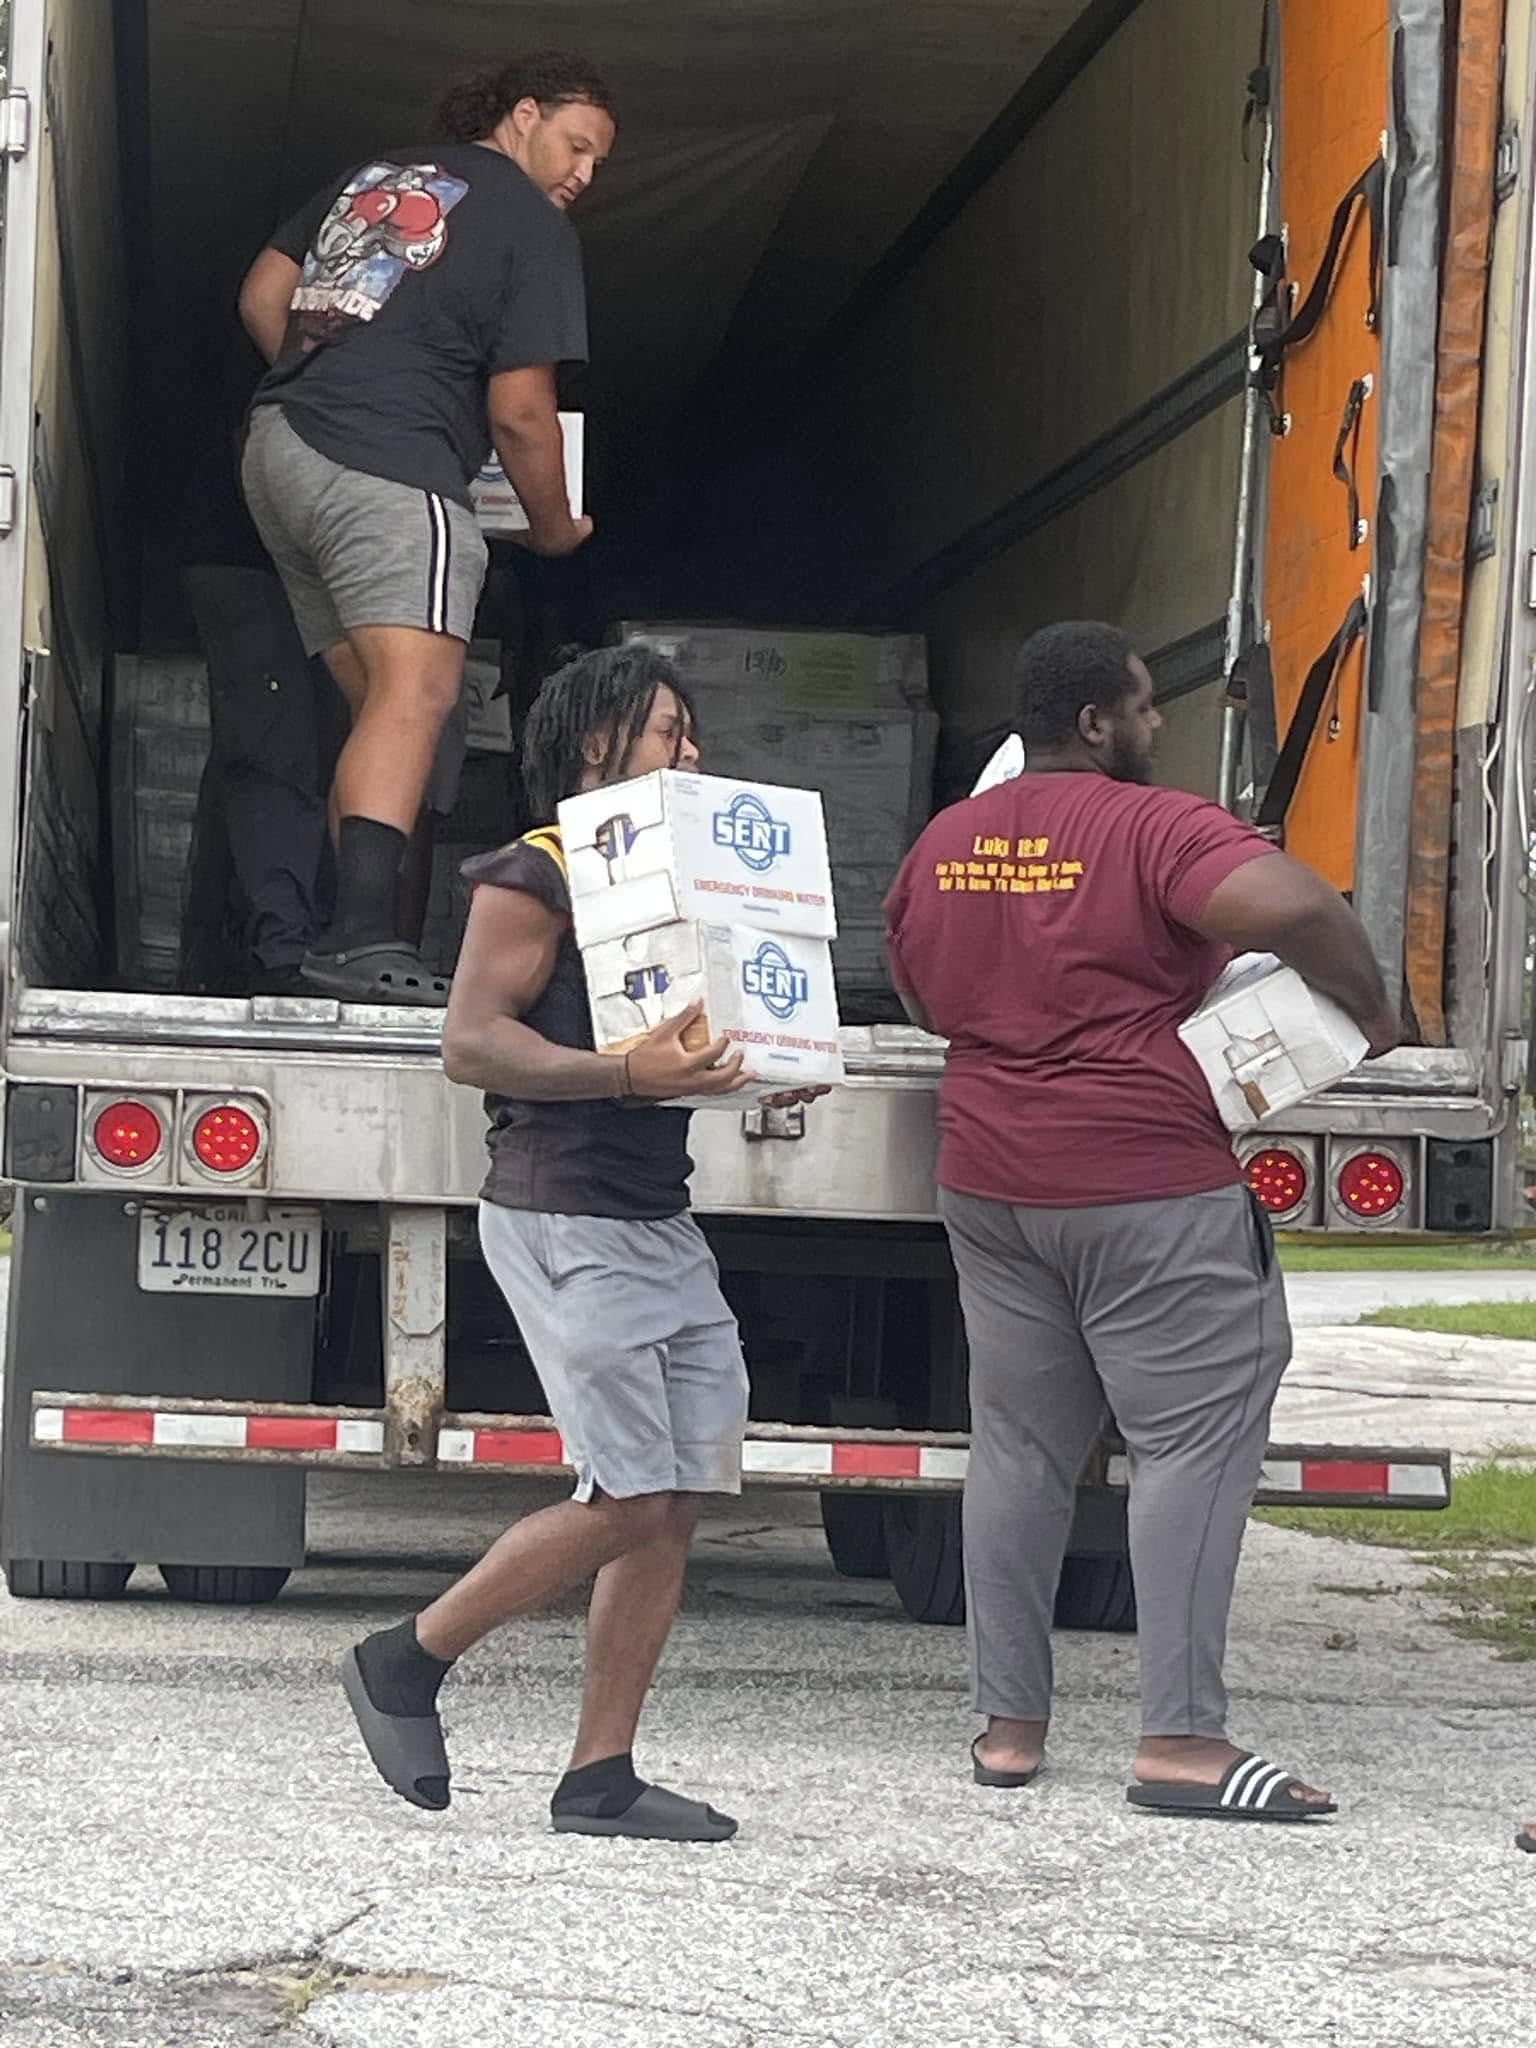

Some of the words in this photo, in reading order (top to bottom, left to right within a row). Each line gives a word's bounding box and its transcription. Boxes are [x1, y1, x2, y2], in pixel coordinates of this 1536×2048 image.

[714, 812, 790, 854] SENT
[743, 960, 808, 1002] SENT
[151, 1225, 222, 1271] 118
[238, 1229, 309, 1274] 2CU
[180, 1273, 252, 1288] Permanent
